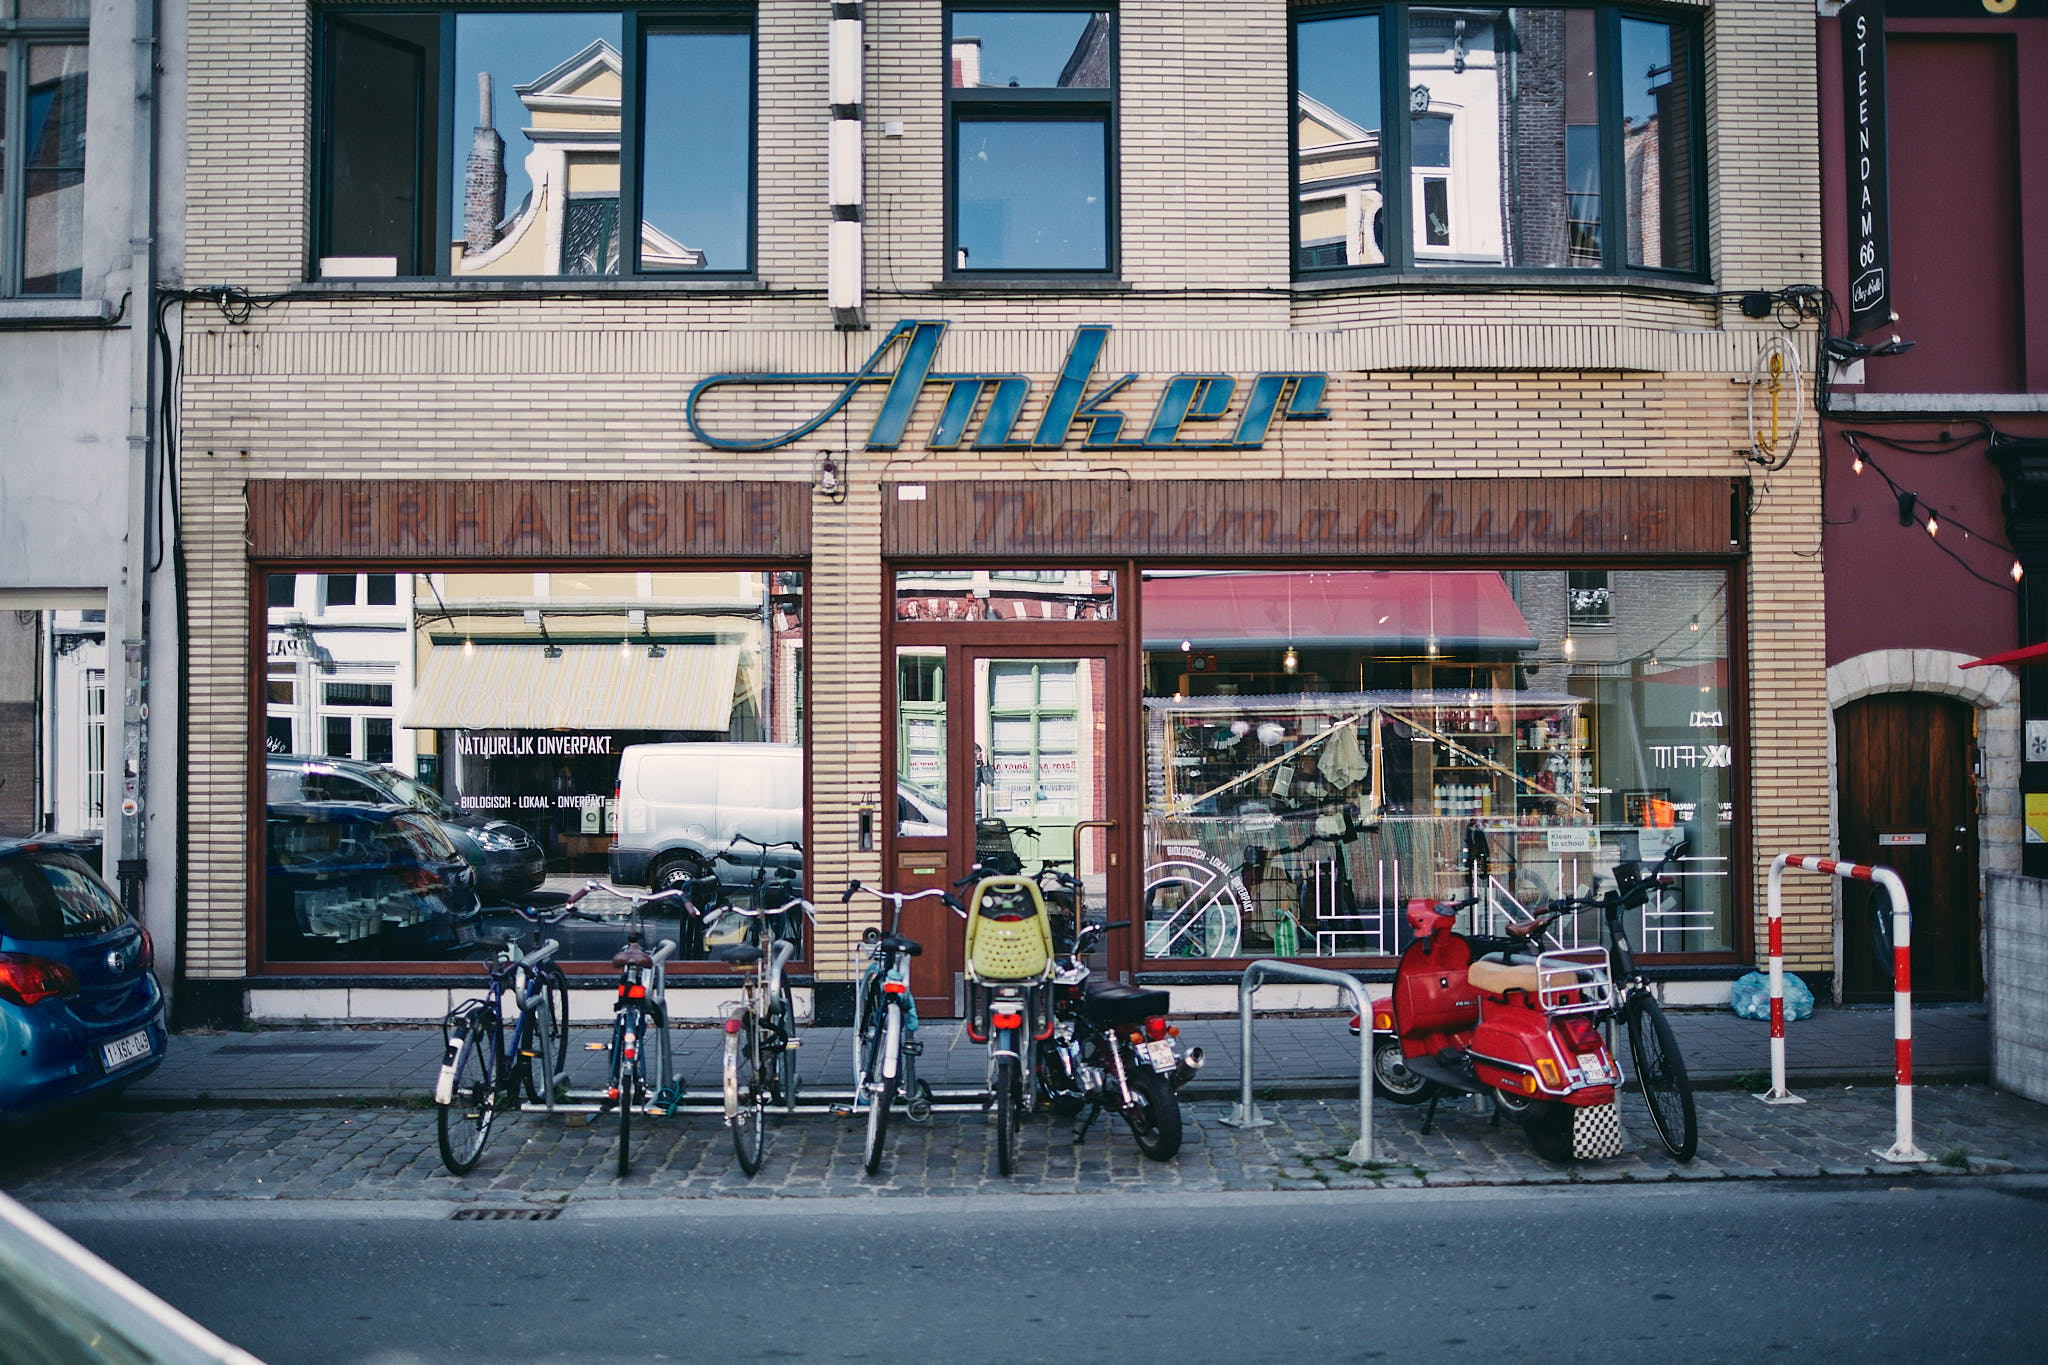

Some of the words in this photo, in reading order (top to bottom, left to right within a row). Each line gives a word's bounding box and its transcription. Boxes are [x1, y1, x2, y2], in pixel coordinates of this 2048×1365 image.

[1856, 15, 1873, 238] STEENDAM
[1860, 240, 1875, 267] 66
[686, 319, 1331, 451] Anker
[278, 489, 780, 547] VERHAEGHE
[456, 736, 534, 755] NATUURLIJK
[537, 736, 612, 755] ONVERPAKT
[460, 796, 511, 809] BIOLOGISCH
[518, 796, 550, 808] LOKAAL
[557, 796, 606, 809] ONVERPAKT
[1166, 846, 1207, 861] BIOLOGISCH
[1208, 855, 1232, 877] LOKAAL
[1230, 875, 1255, 914] ONVERPAKT
